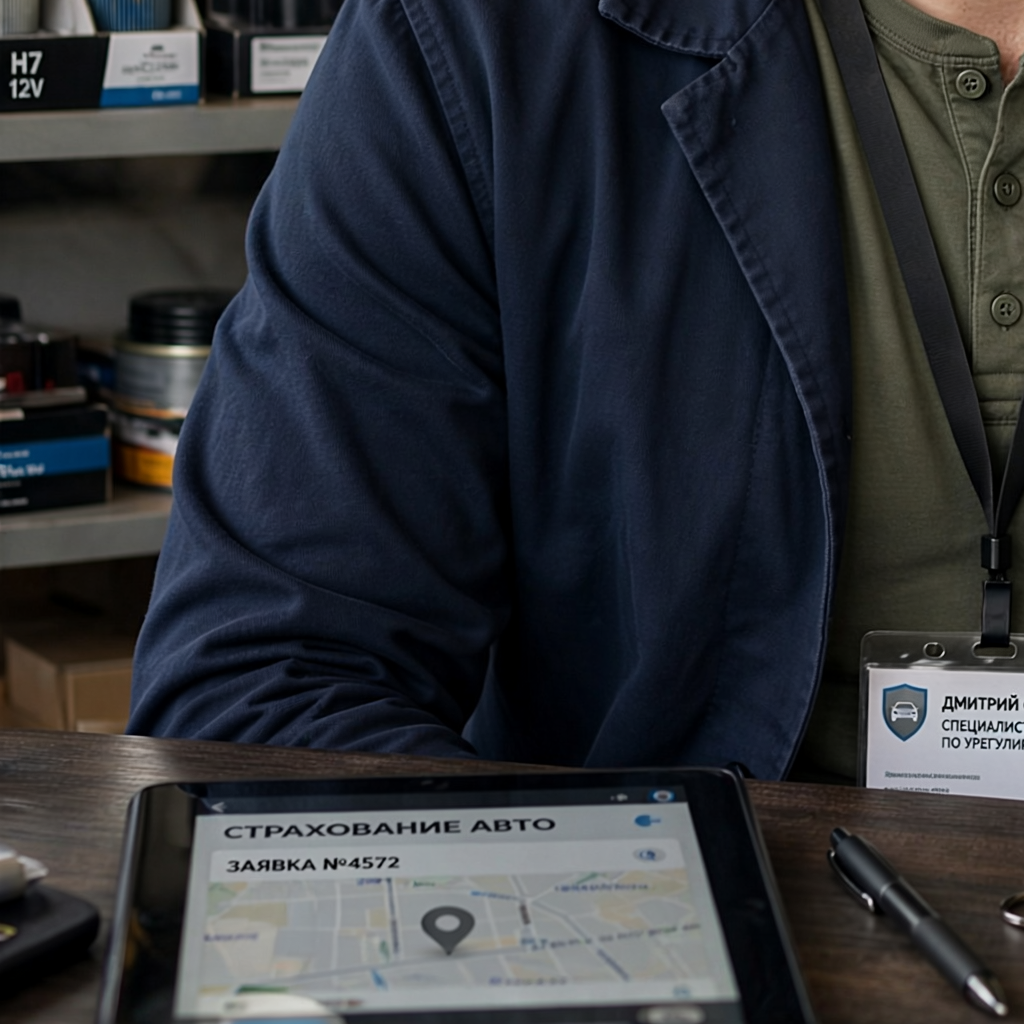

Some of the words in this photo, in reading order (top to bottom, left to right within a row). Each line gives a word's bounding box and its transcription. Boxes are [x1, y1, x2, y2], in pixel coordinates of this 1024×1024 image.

[11, 51, 43, 75] H7
[9, 78, 44, 99] 12V
[941, 694, 1019, 713] ДМИТРИЙ
[941, 737, 961, 749] ПО
[223, 820, 461, 839] СТРАХОВАНИЕ
[470, 818, 556, 833] АВТО
[225, 858, 316, 873] ЗАЯВКА
[323, 856, 400, 871] №4572
